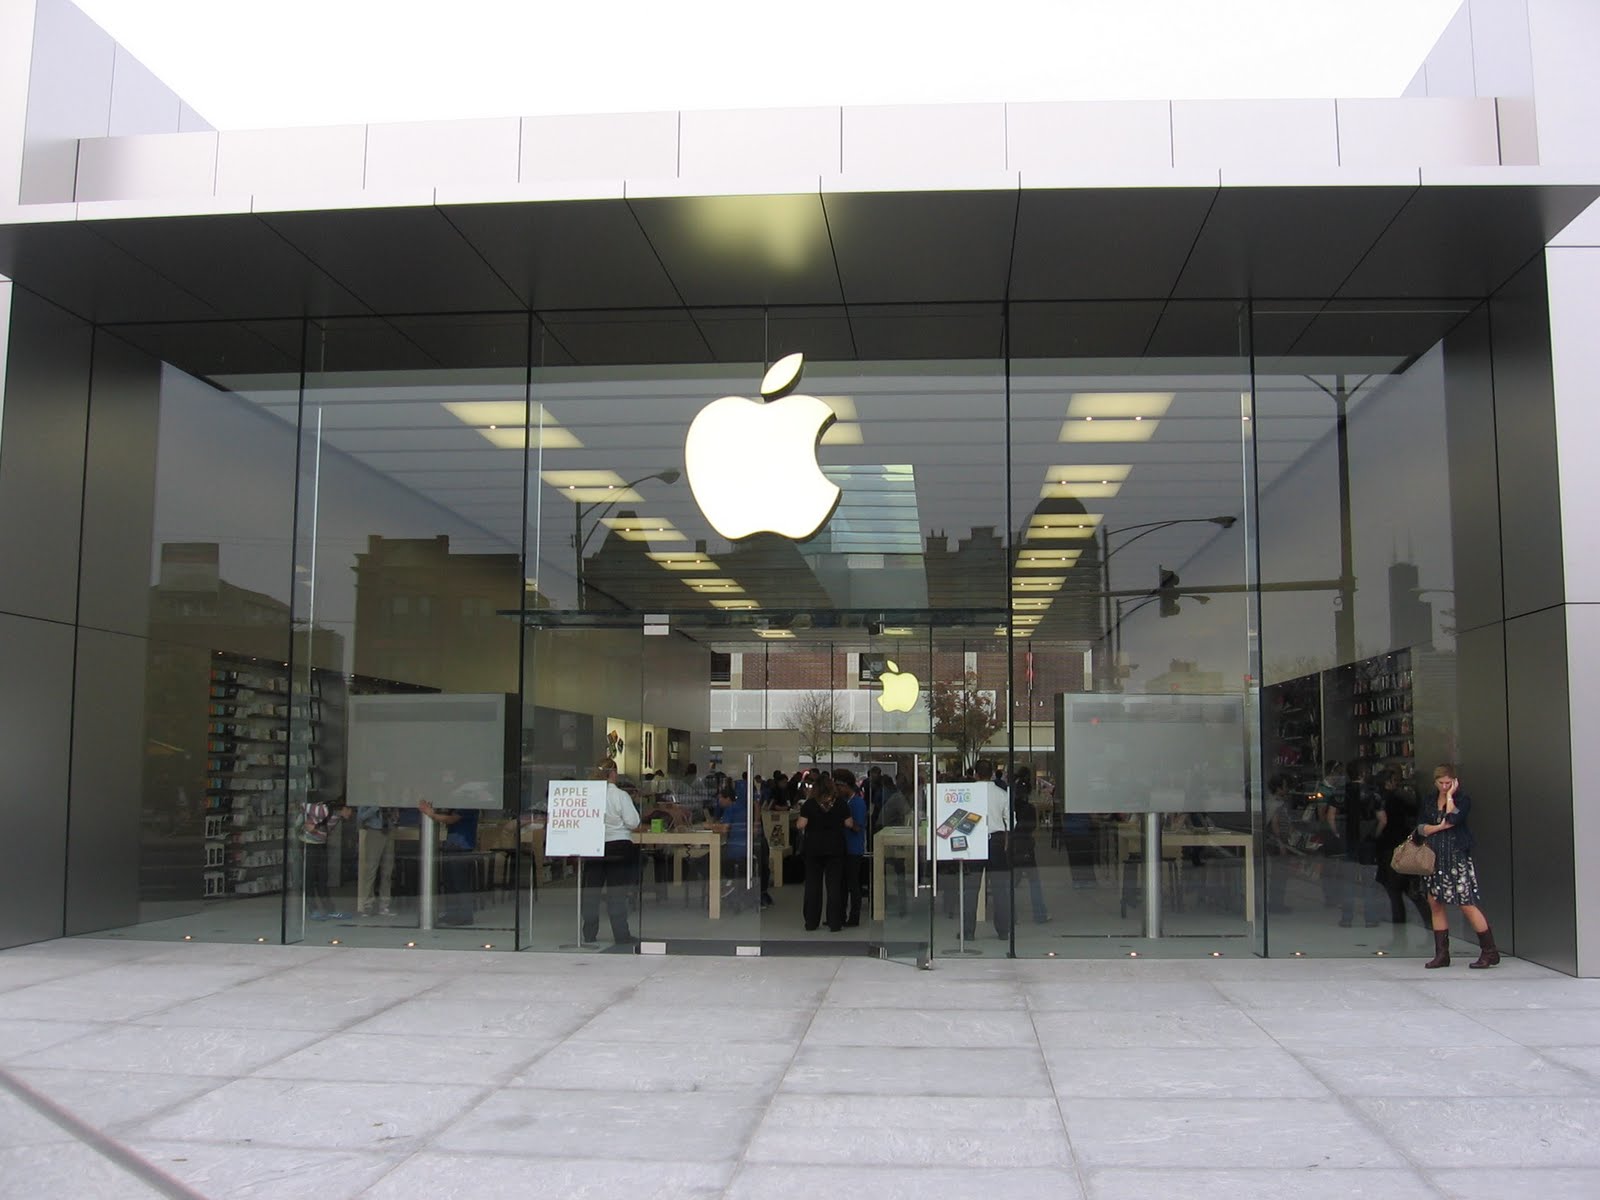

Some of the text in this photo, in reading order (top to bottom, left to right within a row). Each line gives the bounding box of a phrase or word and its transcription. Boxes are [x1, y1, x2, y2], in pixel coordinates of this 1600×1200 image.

[553, 787, 588, 797] APPLE
[553, 798, 588, 808] STORE
[552, 808, 600, 818] LINCOLN
[552, 819, 580, 829] PARK
